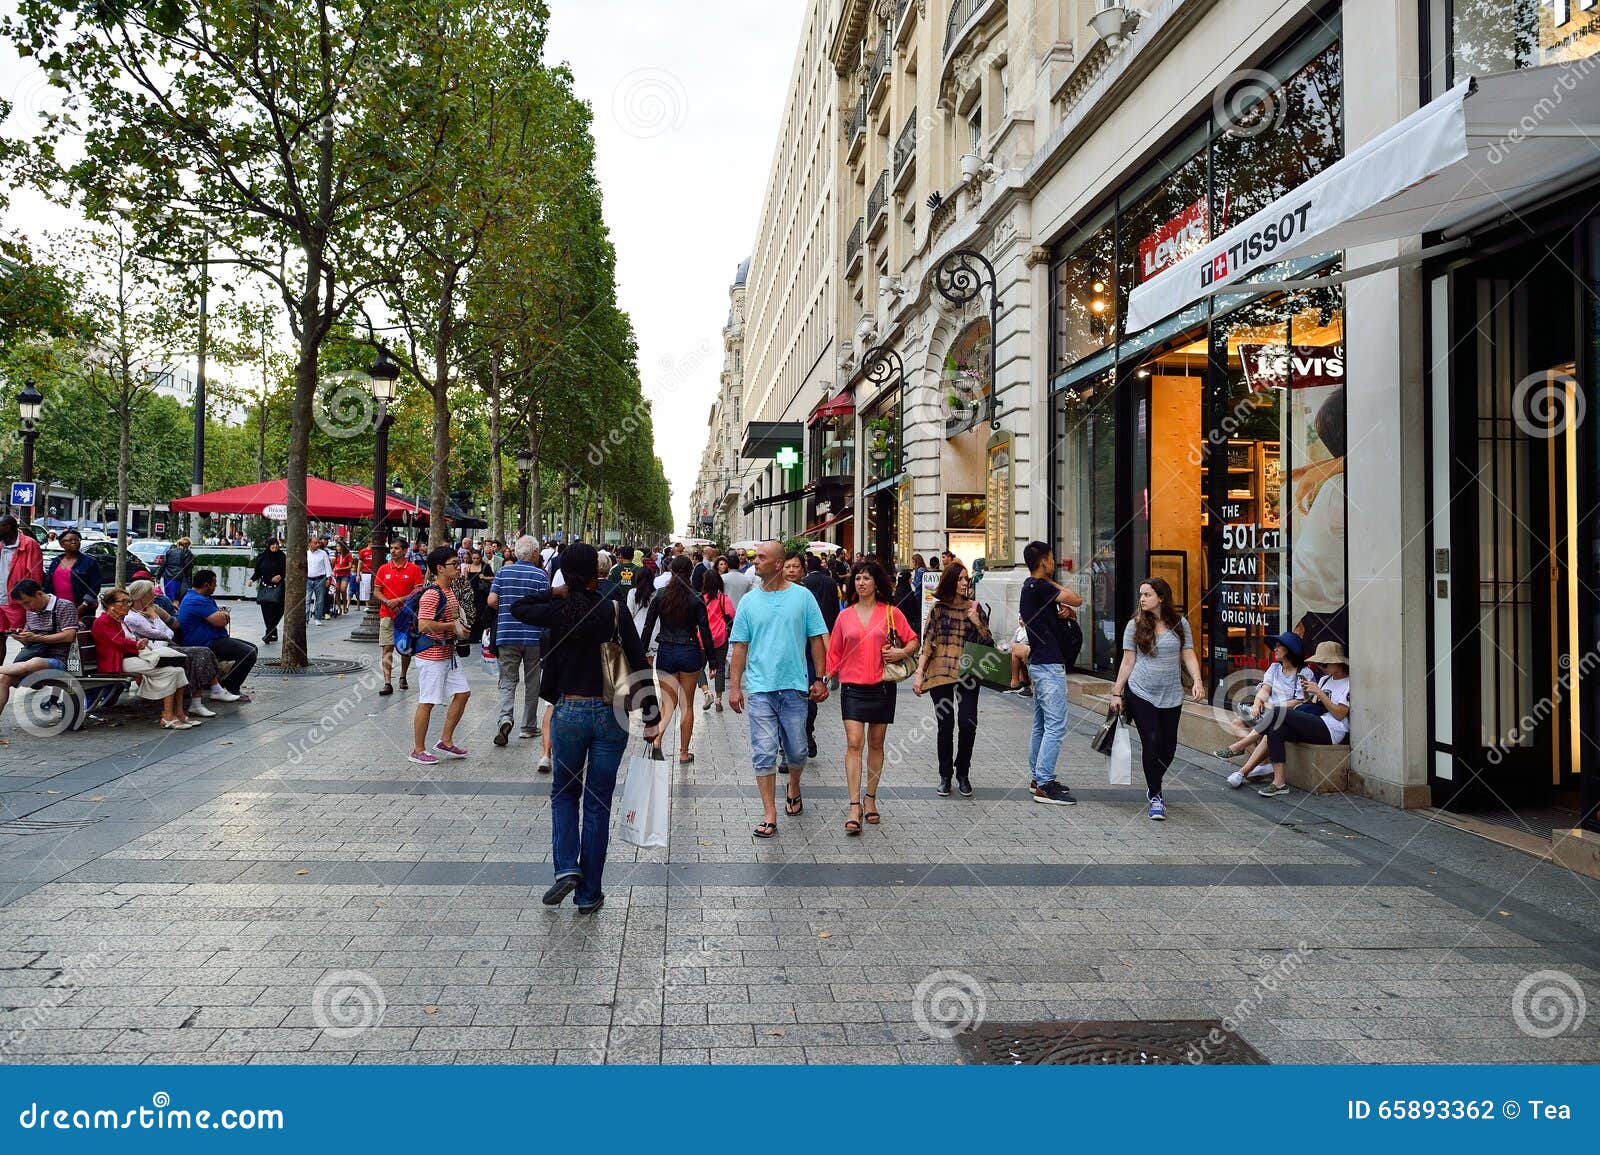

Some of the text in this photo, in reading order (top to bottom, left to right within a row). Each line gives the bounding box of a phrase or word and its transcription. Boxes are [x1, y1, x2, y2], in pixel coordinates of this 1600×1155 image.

[1228, 201, 1312, 270] TISSOT
[14, 489, 33, 497] TAS
[1221, 504, 1240, 519] THE
[1262, 531, 1280, 550] CT
[1221, 557, 1256, 575] JEAN
[1221, 591, 1270, 606] THE NEXT
[1221, 610, 1269, 627] ORIGINAL
